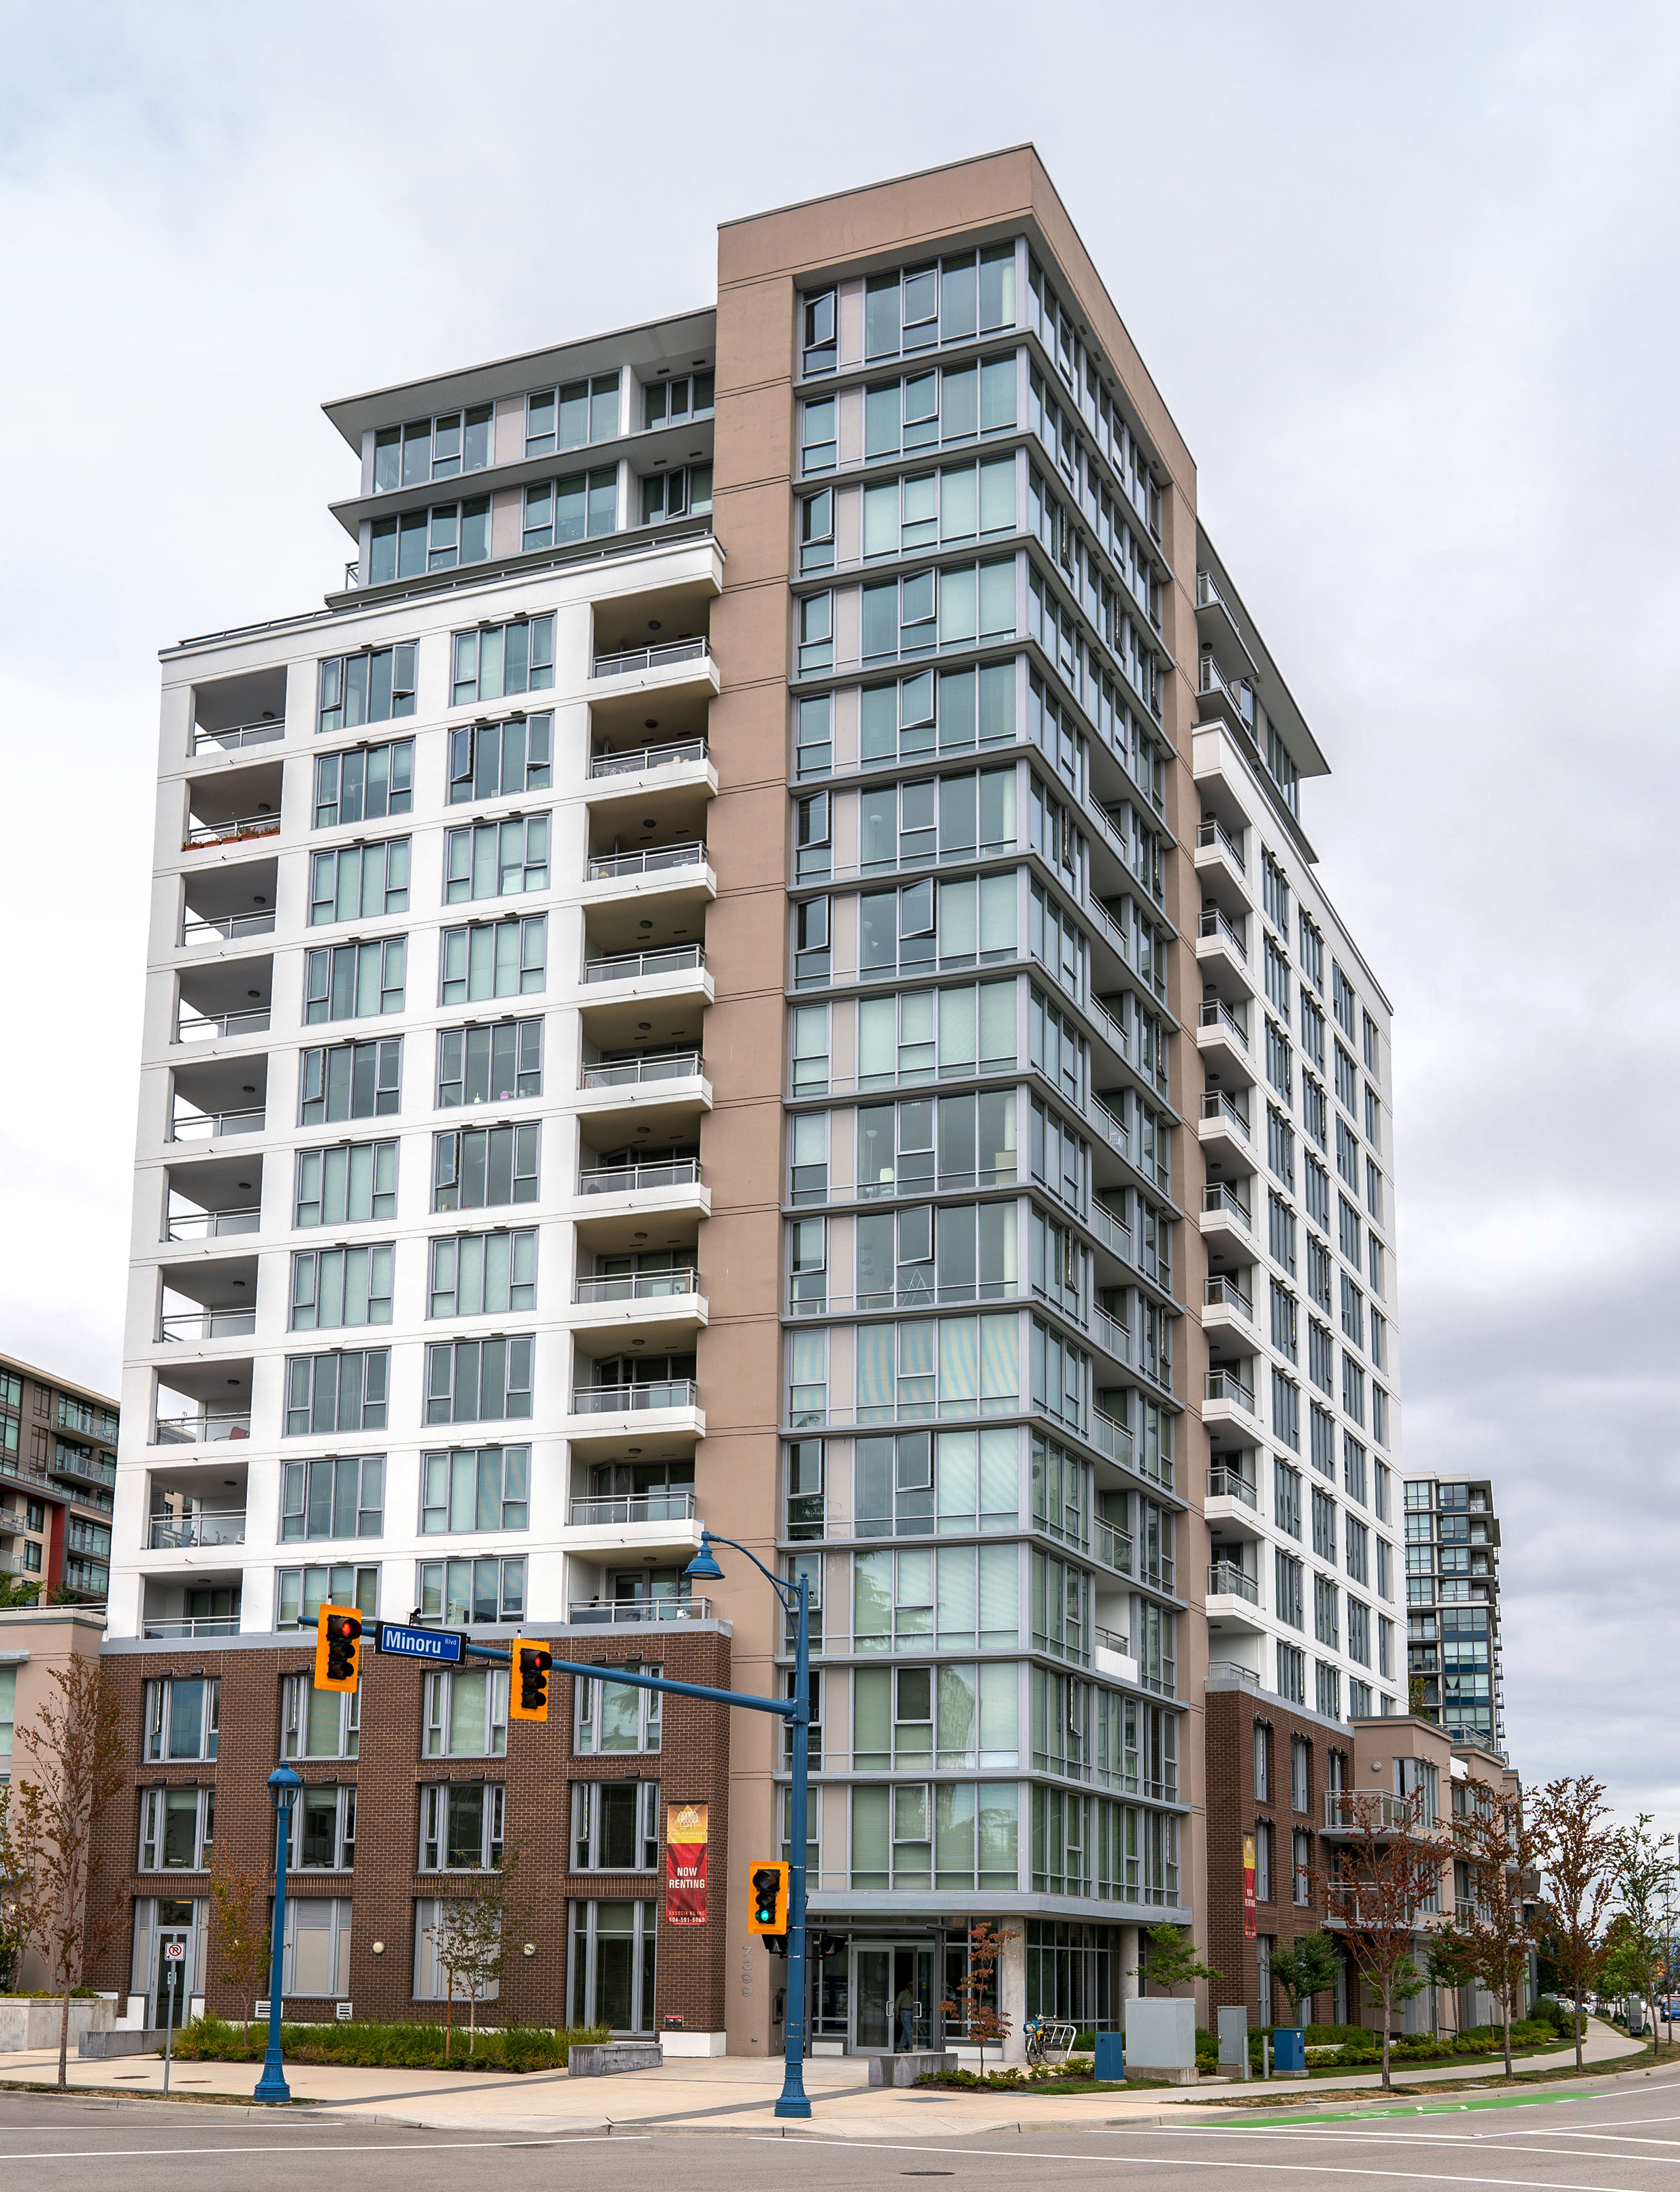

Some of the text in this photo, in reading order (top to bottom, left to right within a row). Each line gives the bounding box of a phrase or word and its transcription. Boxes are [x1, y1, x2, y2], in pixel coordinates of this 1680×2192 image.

[386, 1630, 441, 1654] Minoru
[677, 1867, 697, 1877] NOW
[669, 1879, 705, 1888] RENTING
[741, 1946, 753, 1997] 7399
